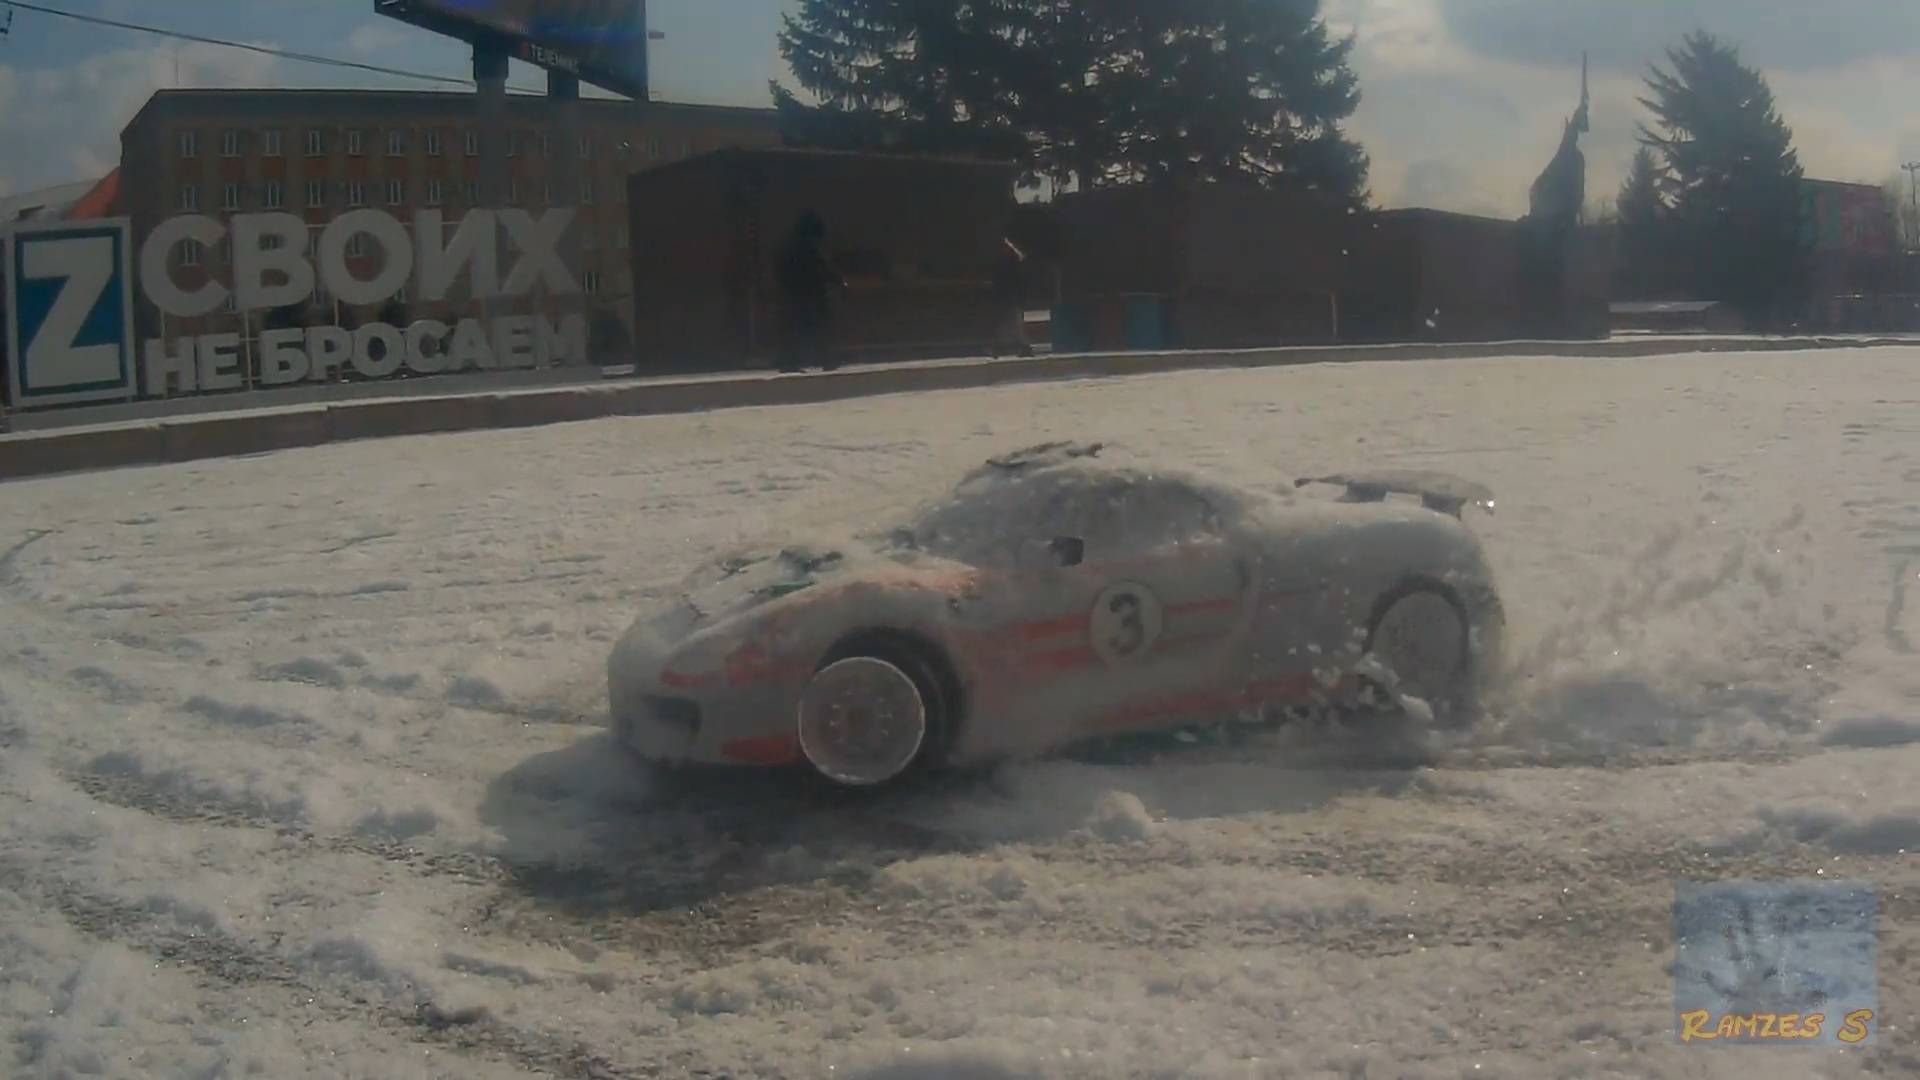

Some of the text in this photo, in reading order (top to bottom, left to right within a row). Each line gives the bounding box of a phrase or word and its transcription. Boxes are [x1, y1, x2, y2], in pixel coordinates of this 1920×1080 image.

[141, 207, 583, 317] СВОИХ
[23, 238, 121, 386] Z
[147, 314, 588, 397] НЕ БРОСАЕМ
[1109, 593, 1145, 655] 3
